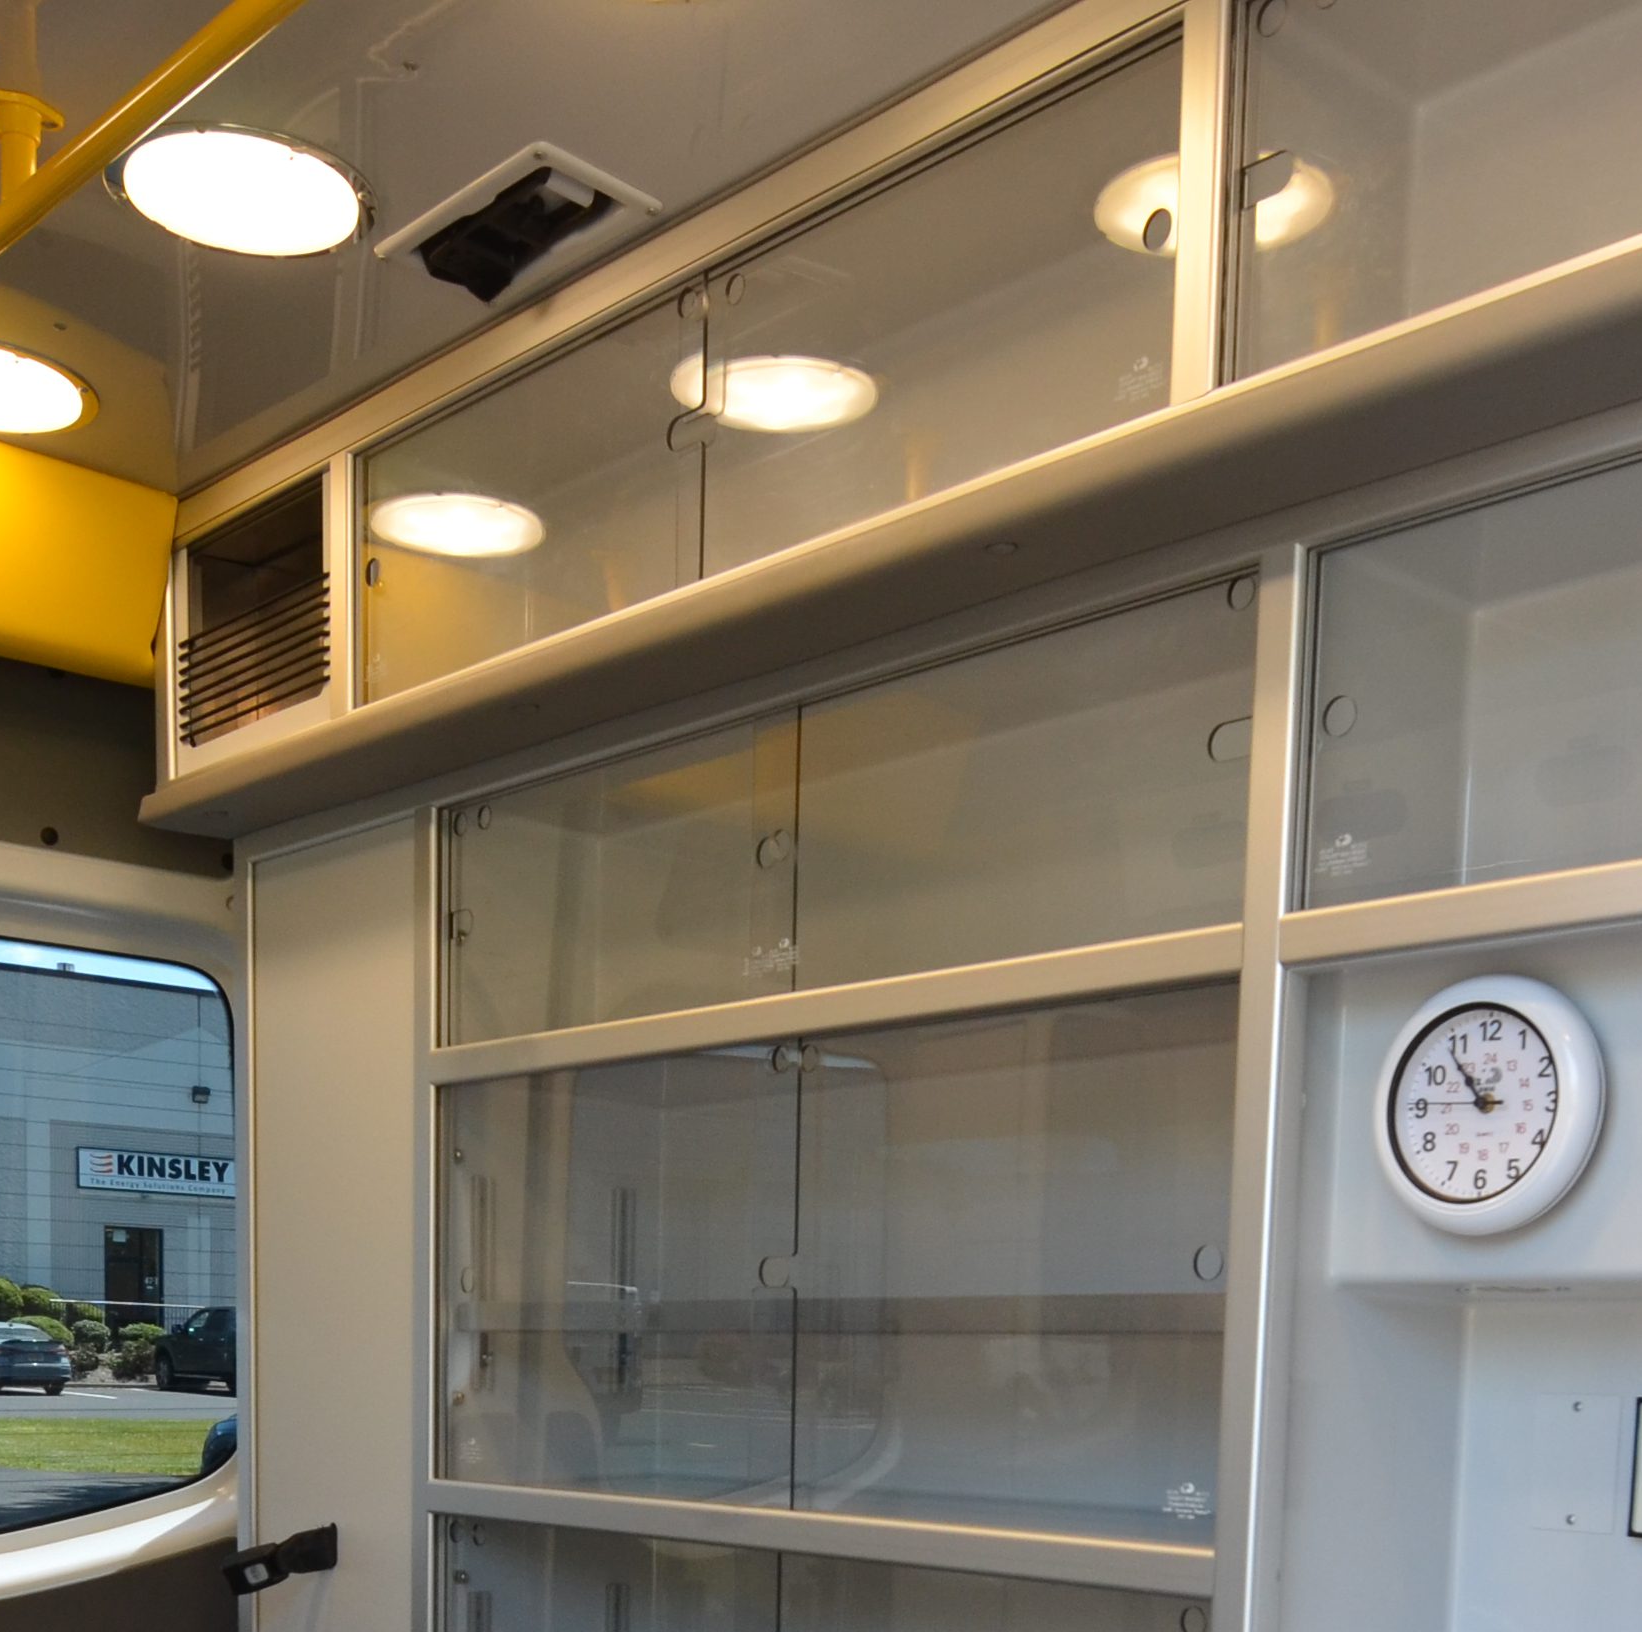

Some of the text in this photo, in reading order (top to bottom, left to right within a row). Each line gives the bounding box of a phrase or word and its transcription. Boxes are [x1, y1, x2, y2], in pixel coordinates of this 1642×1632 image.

[1479, 1020, 1502, 1041] 12
[1518, 1029, 1527, 1050] 1
[1448, 1034, 1468, 1054] 11
[1483, 1053, 1498, 1065] 24
[1507, 1060, 1518, 1072] 13
[1538, 1056, 1552, 1078] 2
[1425, 1065, 1446, 1086] 10
[1519, 1078, 1530, 1089] 14
[1446, 1082, 1460, 1093] 22
[1414, 1098, 1428, 1119] 9
[1523, 1100, 1534, 1112] 15
[1545, 1091, 1557, 1112] 3
[1445, 1123, 1460, 1136] 20
[1531, 1129, 1545, 1148] 4
[1422, 1132, 1436, 1152] 8
[1459, 1142, 1470, 1154] 19
[1498, 1142, 1509, 1153] 17
[117, 1154, 230, 1183] KINSLEY
[1446, 1160, 1459, 1181] 7
[1507, 1159, 1520, 1180] 5
[90, 1177, 226, 1195] The Energy Solutions Company
[1474, 1169, 1487, 1190] 6
